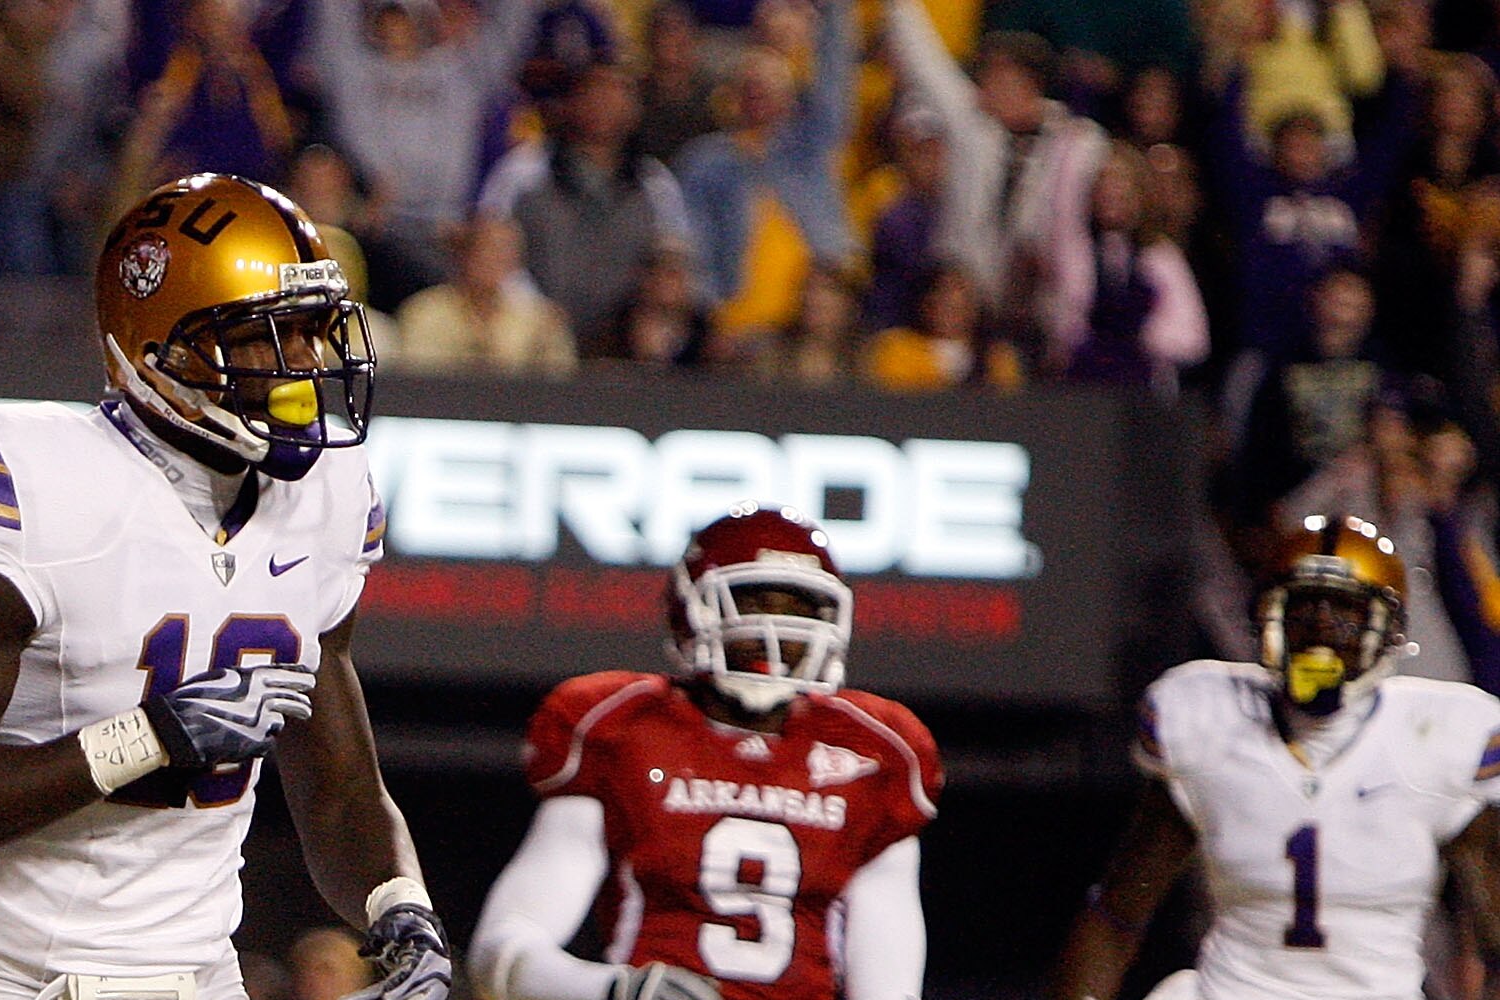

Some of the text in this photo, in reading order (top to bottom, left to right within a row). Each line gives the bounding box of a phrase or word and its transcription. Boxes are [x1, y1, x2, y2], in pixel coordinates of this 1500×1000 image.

[364, 416, 1030, 578] ERADE
[664, 777, 848, 831] ARKANSAS
[699, 815, 802, 984] 9
[1283, 822, 1327, 949] 1
